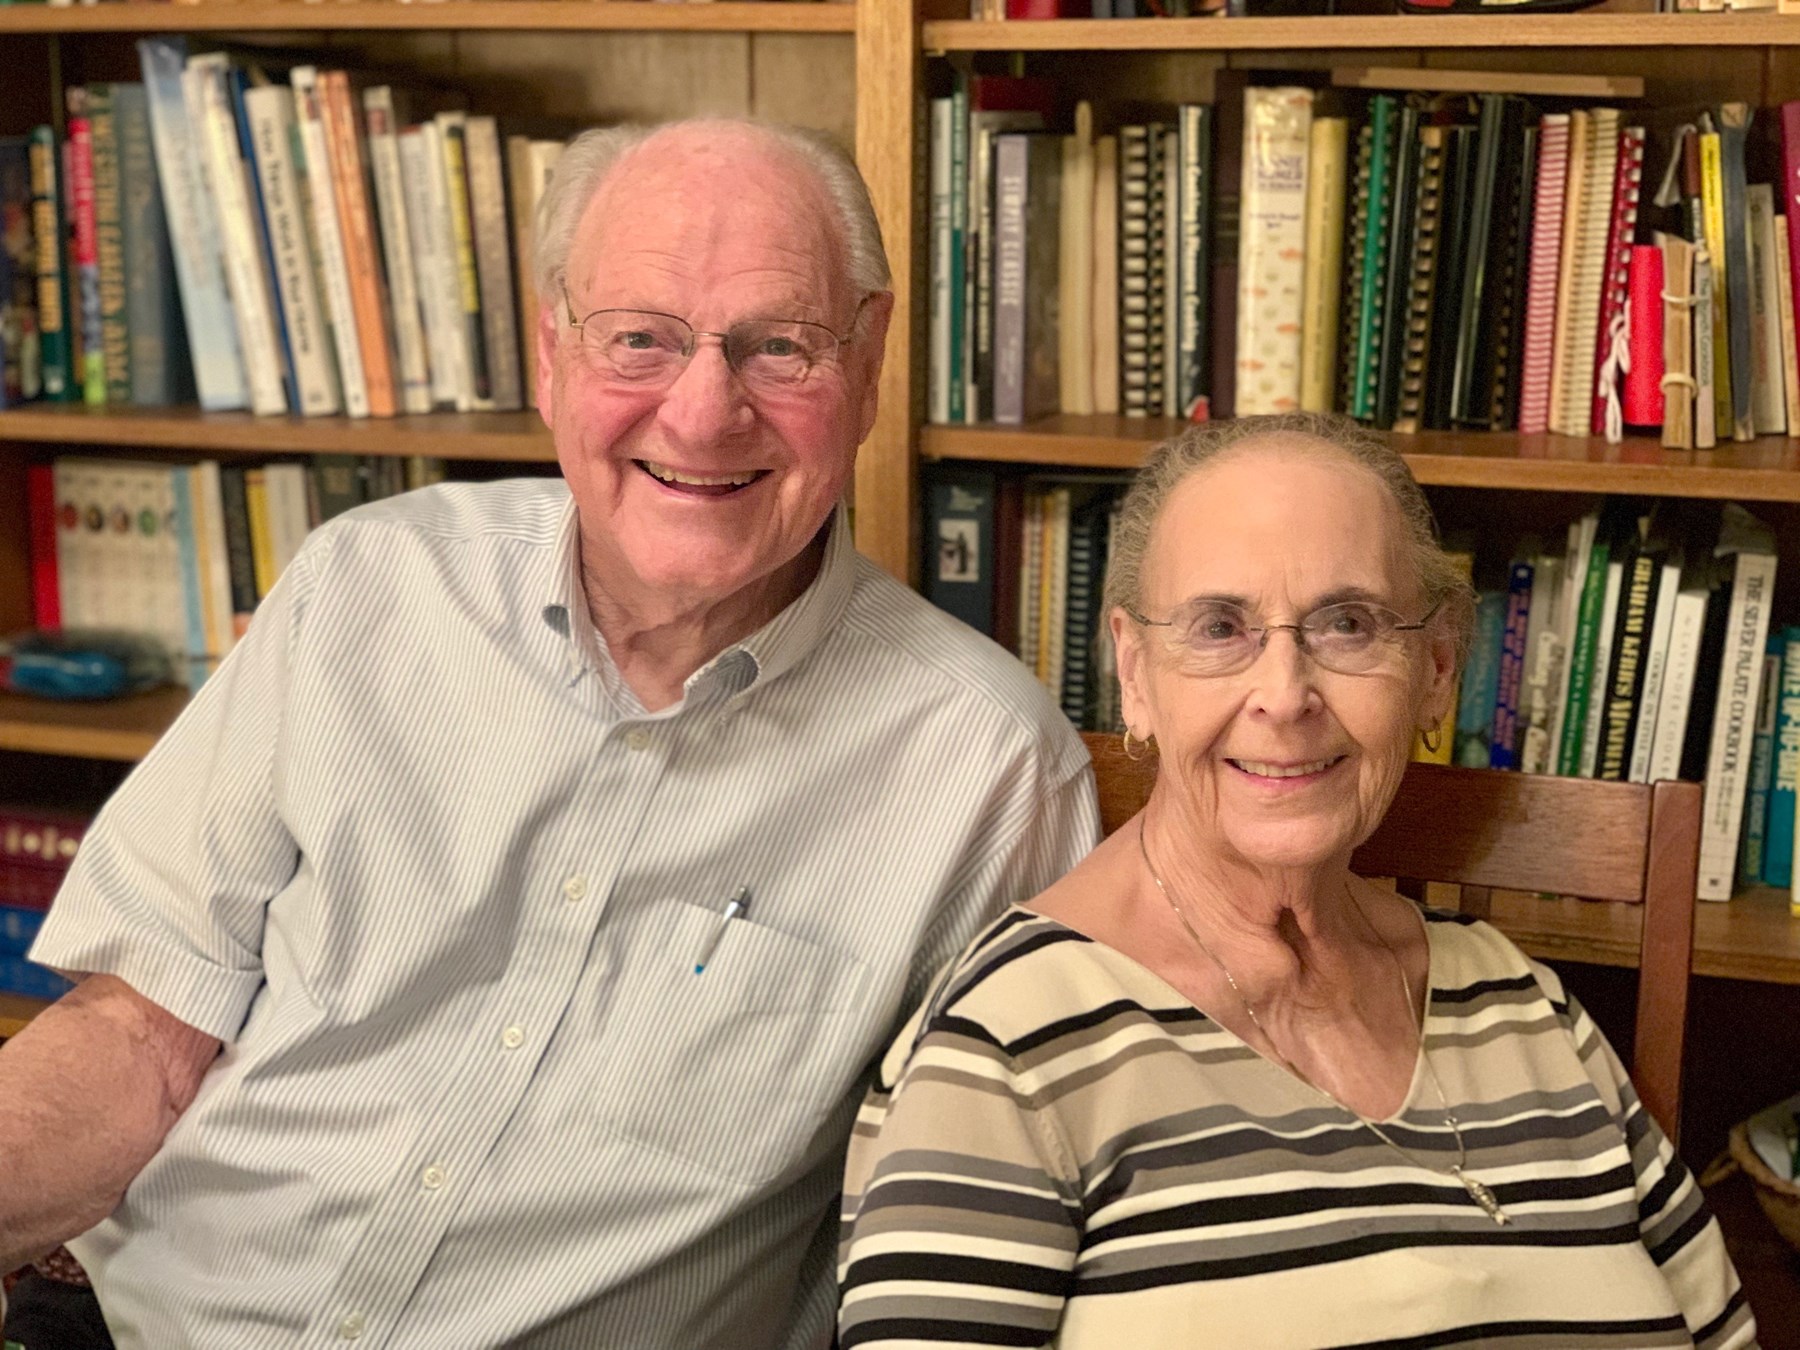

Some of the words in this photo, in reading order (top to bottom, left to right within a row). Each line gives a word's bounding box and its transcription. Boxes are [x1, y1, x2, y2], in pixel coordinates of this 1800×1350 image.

[1002, 175, 1021, 233] SIMPLY
[1001, 239, 1021, 306] CLASSIC
[1701, 336, 1711, 386] Cookbook
[1625, 557, 1653, 634] GRAHAM
[1747, 575, 1764, 601] THE
[1741, 606, 1759, 646] SILVER
[1615, 636, 1641, 697] KERR'S
[1671, 632, 1690, 711] LAVENDER
[1734, 649, 1753, 696] PALATE
[1723, 701, 1747, 773] COOKBOOK
